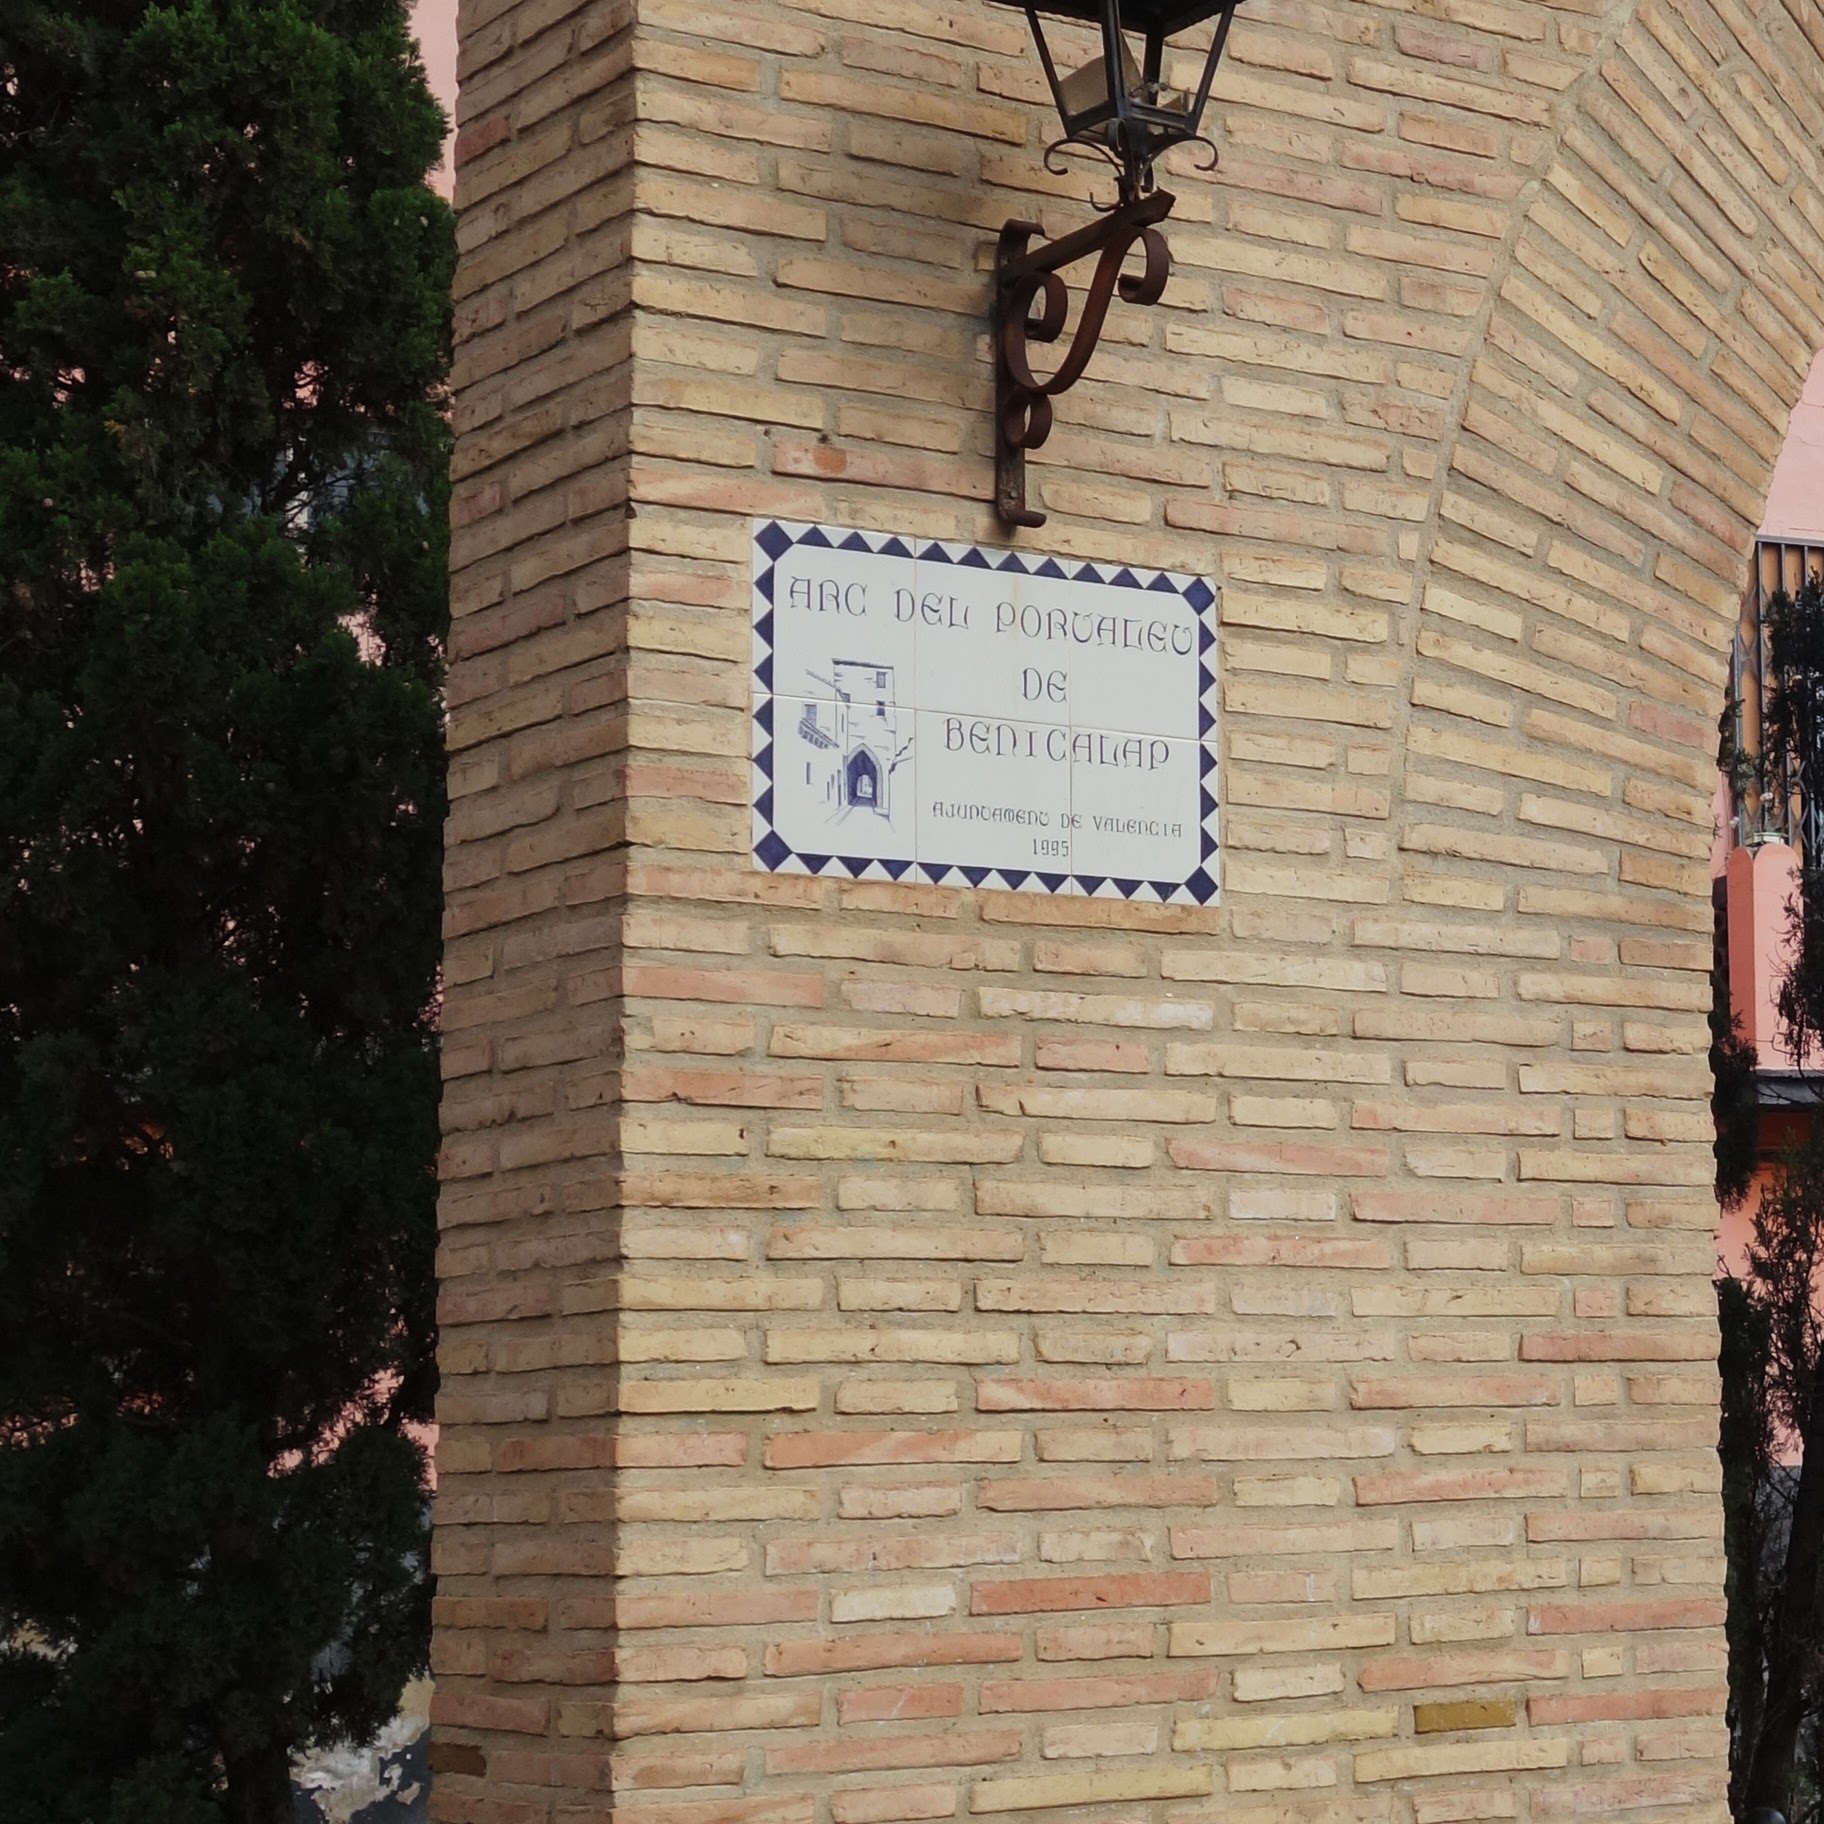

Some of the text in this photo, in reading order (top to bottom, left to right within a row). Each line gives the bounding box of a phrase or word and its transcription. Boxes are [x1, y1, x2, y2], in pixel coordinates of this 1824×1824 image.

[790, 576, 1193, 656] ARC DEL PORTALET
[1022, 667, 1068, 703] DE
[943, 717, 1170, 770] BENICALAP
[932, 801, 1182, 838] AJUNTAMENT DE VALENCIA
[1032, 837, 1070, 857] 1995
